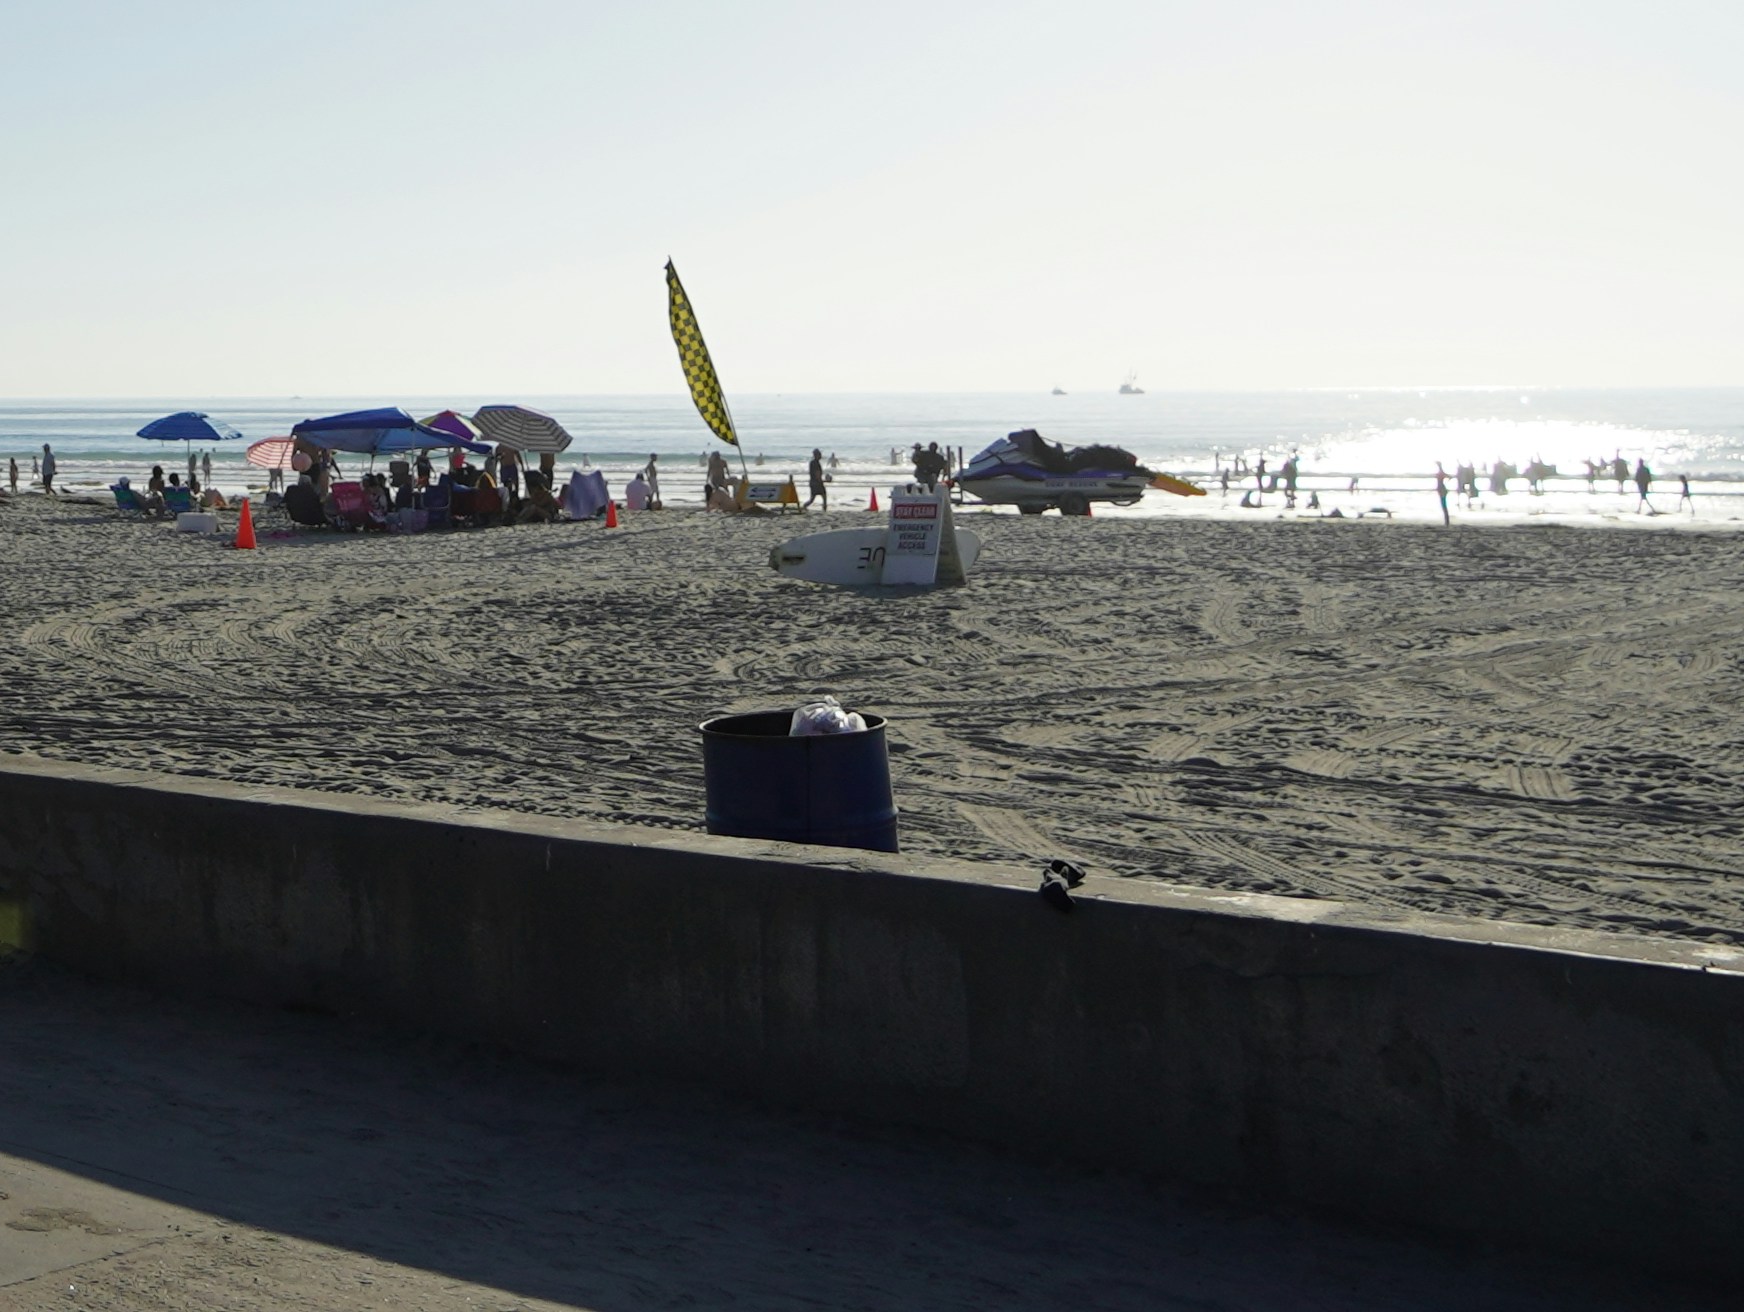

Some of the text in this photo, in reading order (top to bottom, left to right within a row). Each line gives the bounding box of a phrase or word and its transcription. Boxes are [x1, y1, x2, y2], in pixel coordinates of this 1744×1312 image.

[895, 505, 936, 517] STAY CLEAR
[893, 523, 934, 532] EMERGENCY
[899, 532, 926, 540] VEHICLE
[897, 540, 926, 550] ACCESS
